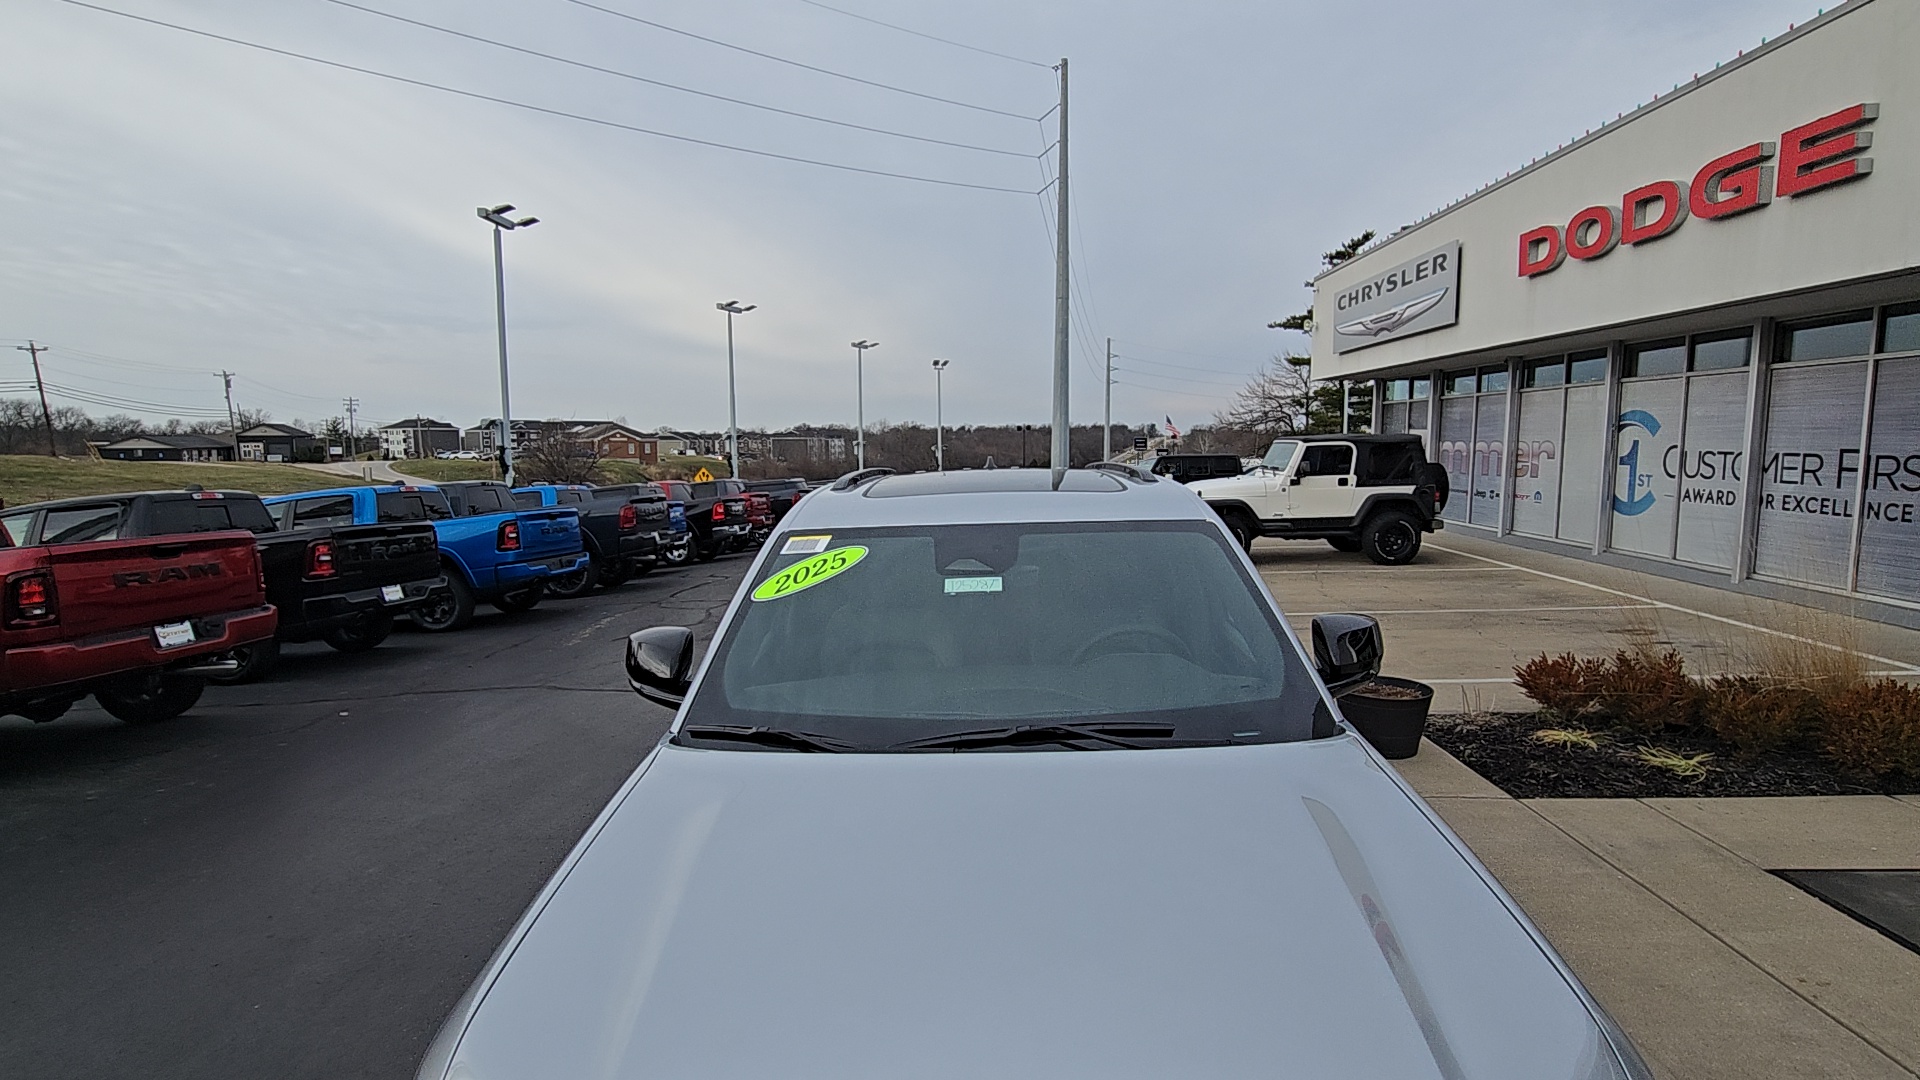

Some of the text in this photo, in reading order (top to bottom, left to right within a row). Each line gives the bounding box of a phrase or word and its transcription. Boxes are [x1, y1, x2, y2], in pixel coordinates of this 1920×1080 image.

[1517, 102, 1880, 278] DODGE
[1337, 253, 1448, 311] CHRYSLER
[1682, 487, 1737, 506] AWARD
[1781, 494, 1915, 523] EXCELLNCE
[371, 541, 416, 560] RAM
[112, 561, 221, 589] RAM
[773, 550, 847, 596] 2025
